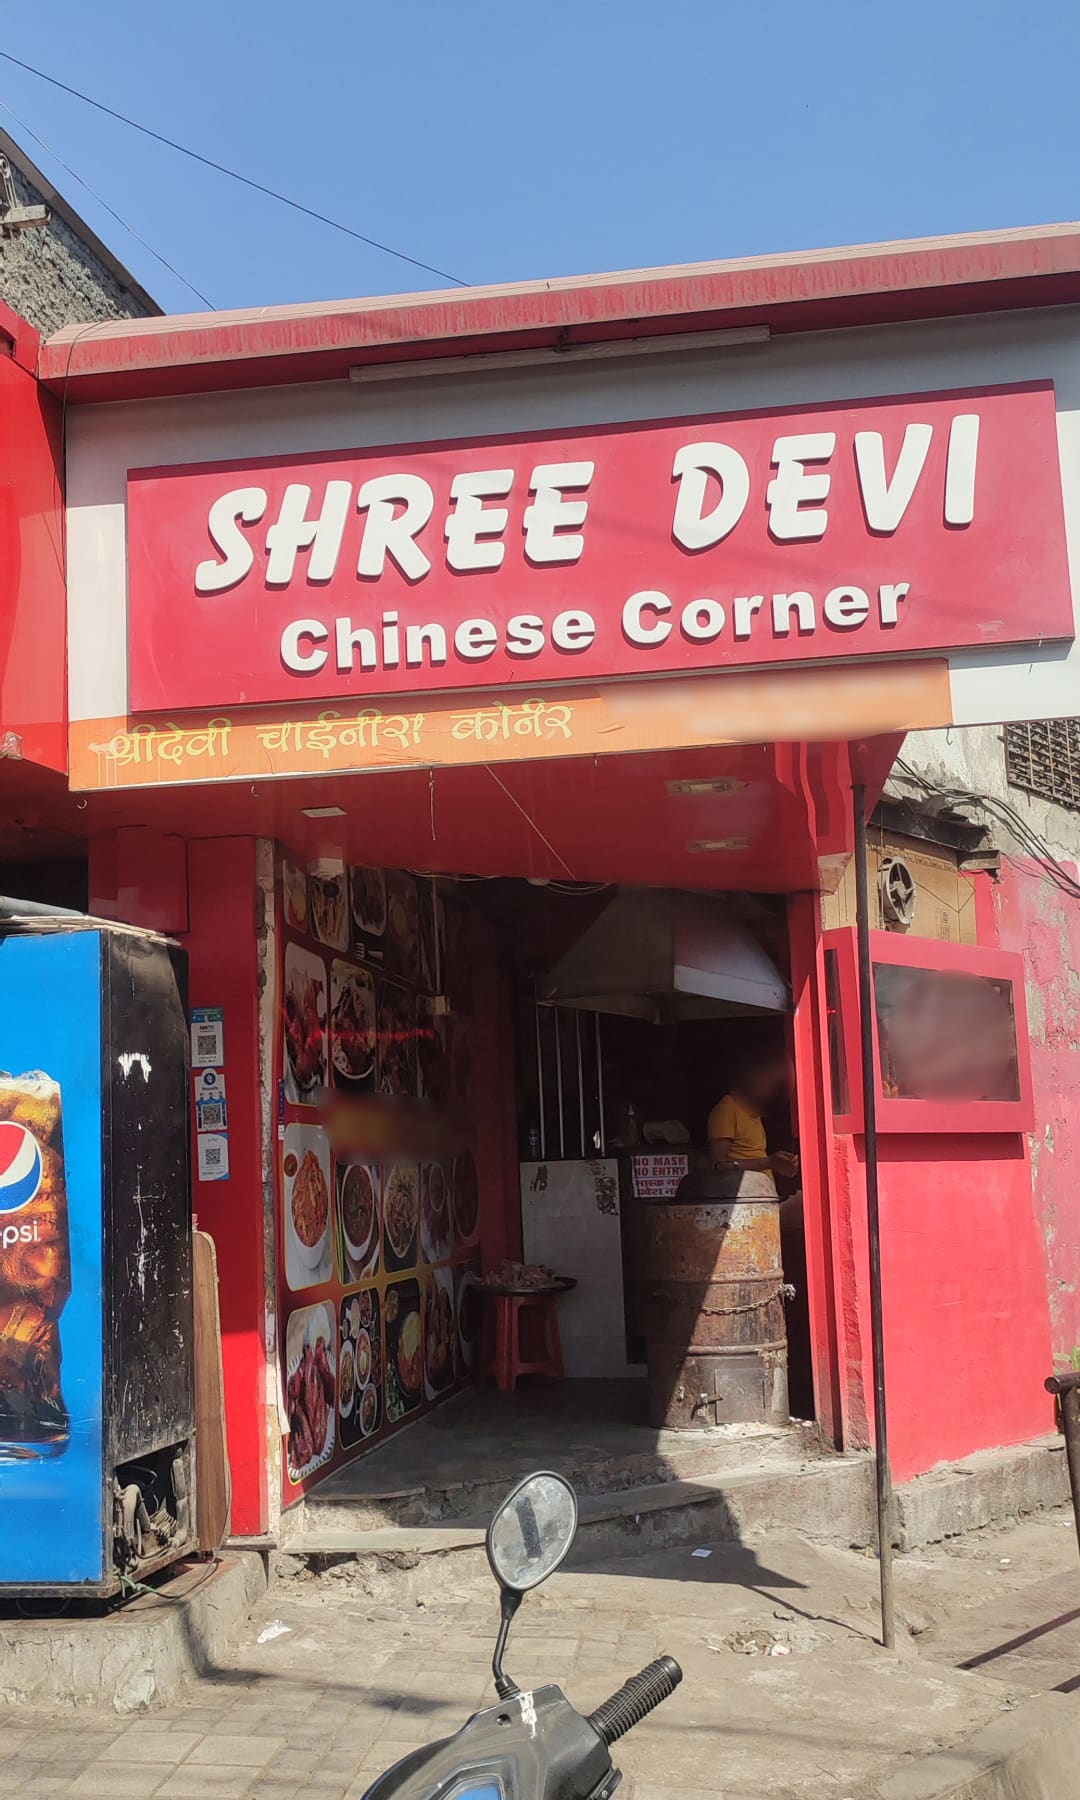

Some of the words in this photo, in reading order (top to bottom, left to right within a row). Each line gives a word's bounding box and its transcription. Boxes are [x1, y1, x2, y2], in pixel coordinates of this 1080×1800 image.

[194, 461, 595, 593] SHREE
[672, 413, 980, 549] DEVI
[281, 609, 596, 672] Chinese
[622, 582, 911, 644] Corner
[653, 1156, 686, 1166] MASK
[653, 1166, 686, 1176] ENTRY
[0, 1220, 41, 1248] psi
